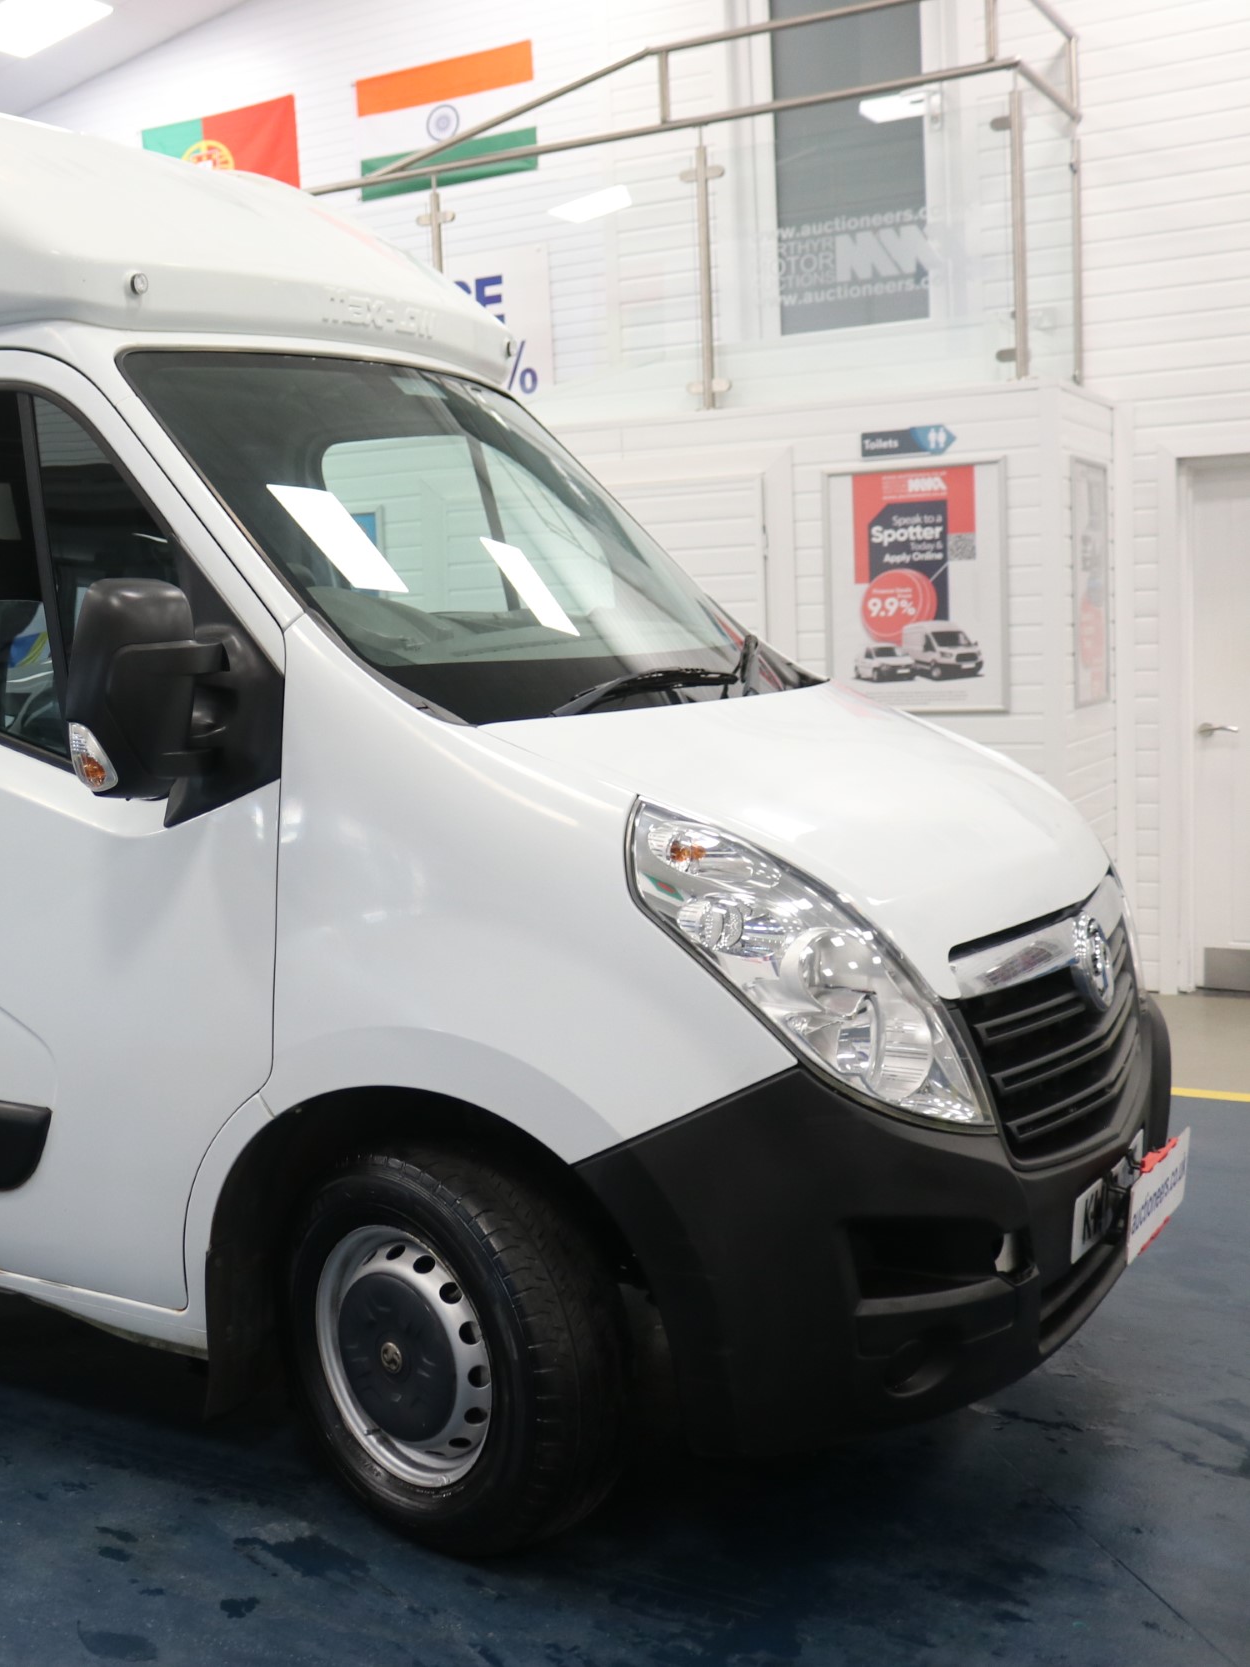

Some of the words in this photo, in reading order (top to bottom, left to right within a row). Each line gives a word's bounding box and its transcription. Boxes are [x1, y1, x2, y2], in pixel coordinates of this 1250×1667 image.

[863, 437, 898, 450] Toilets
[892, 515, 922, 527] Speak
[924, 515, 934, 524] to
[871, 525, 943, 547] Spotter
[910, 541, 935, 552] Today
[883, 553, 911, 564] Apply
[912, 551, 943, 562] Online
[868, 597, 917, 617] 9.9%
